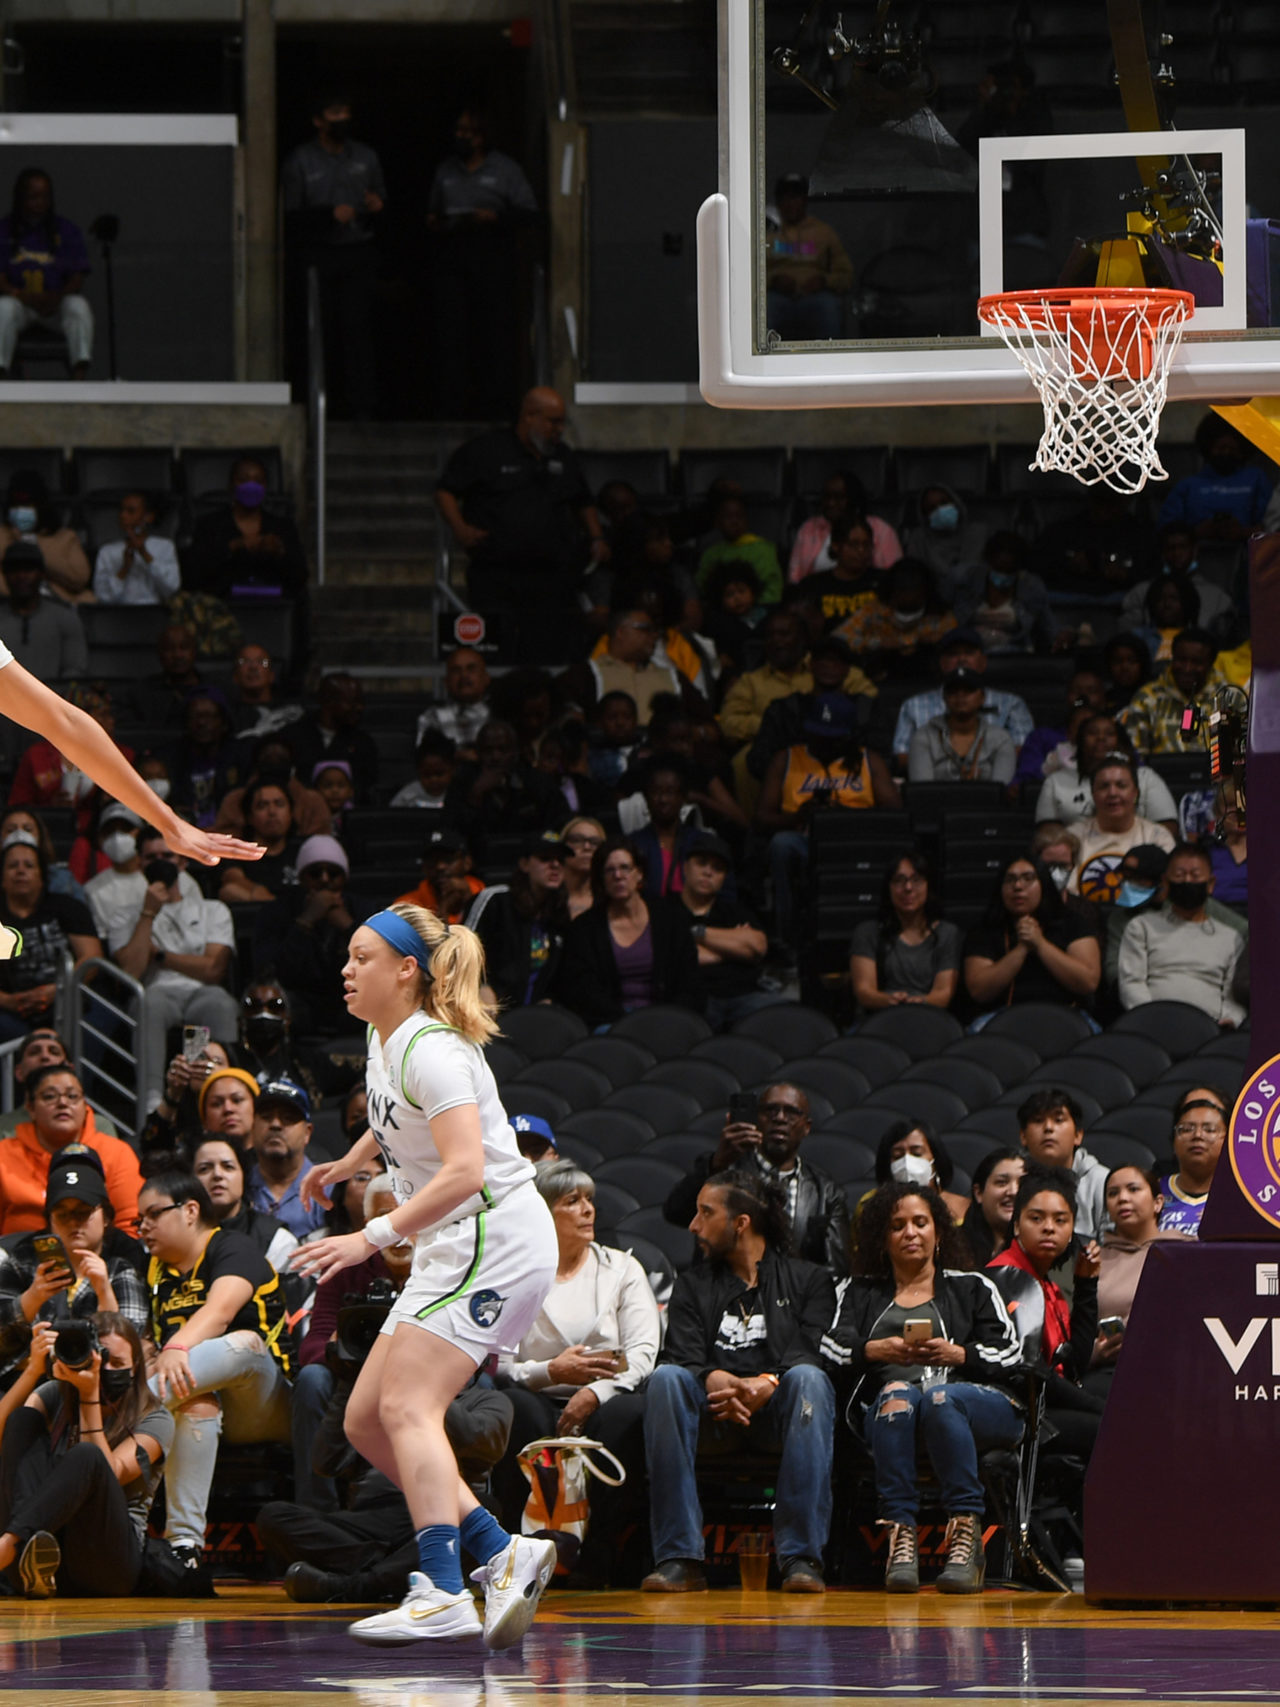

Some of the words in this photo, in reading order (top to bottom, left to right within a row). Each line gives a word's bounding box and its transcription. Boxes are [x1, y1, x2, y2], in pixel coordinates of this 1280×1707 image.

[367, 1088, 401, 1131] NX
[1238, 1079, 1276, 1145] LOS
[65, 1171, 79, 1185] 3
[160, 1293, 207, 1316] NGEL
